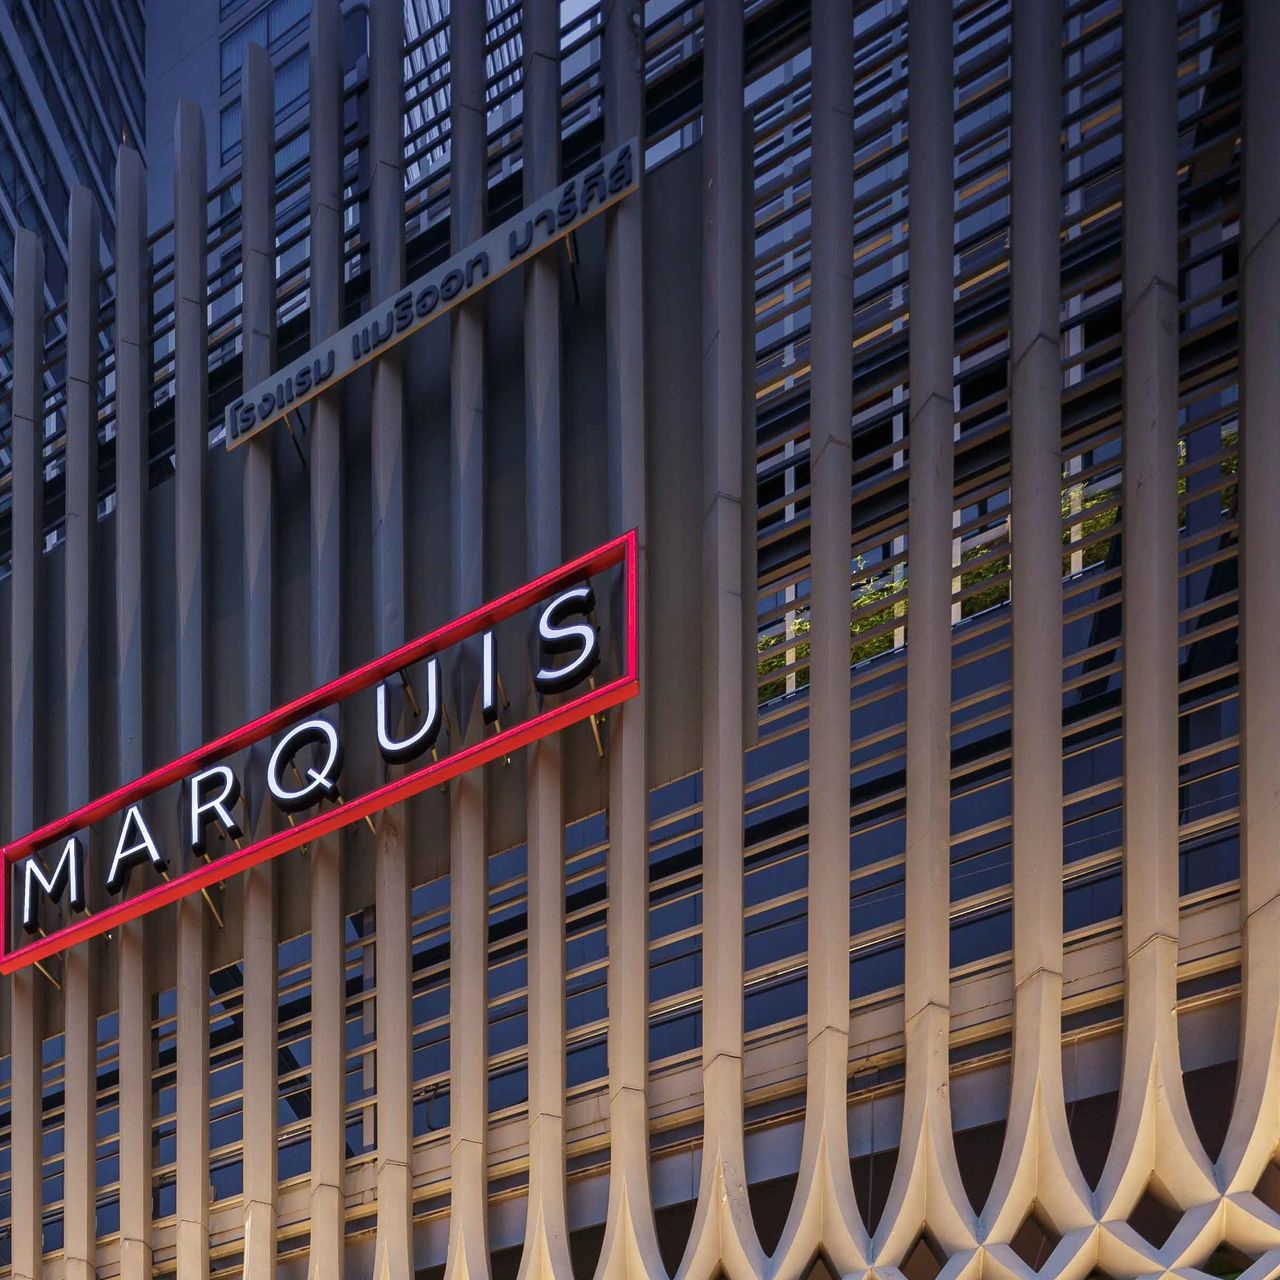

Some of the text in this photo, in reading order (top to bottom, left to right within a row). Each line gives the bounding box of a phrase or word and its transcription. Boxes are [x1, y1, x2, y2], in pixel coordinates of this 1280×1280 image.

[229, 348, 336, 440] โรงแรม
[351, 251, 490, 361] แมริออท
[22, 583, 599, 933] MARQUIS
